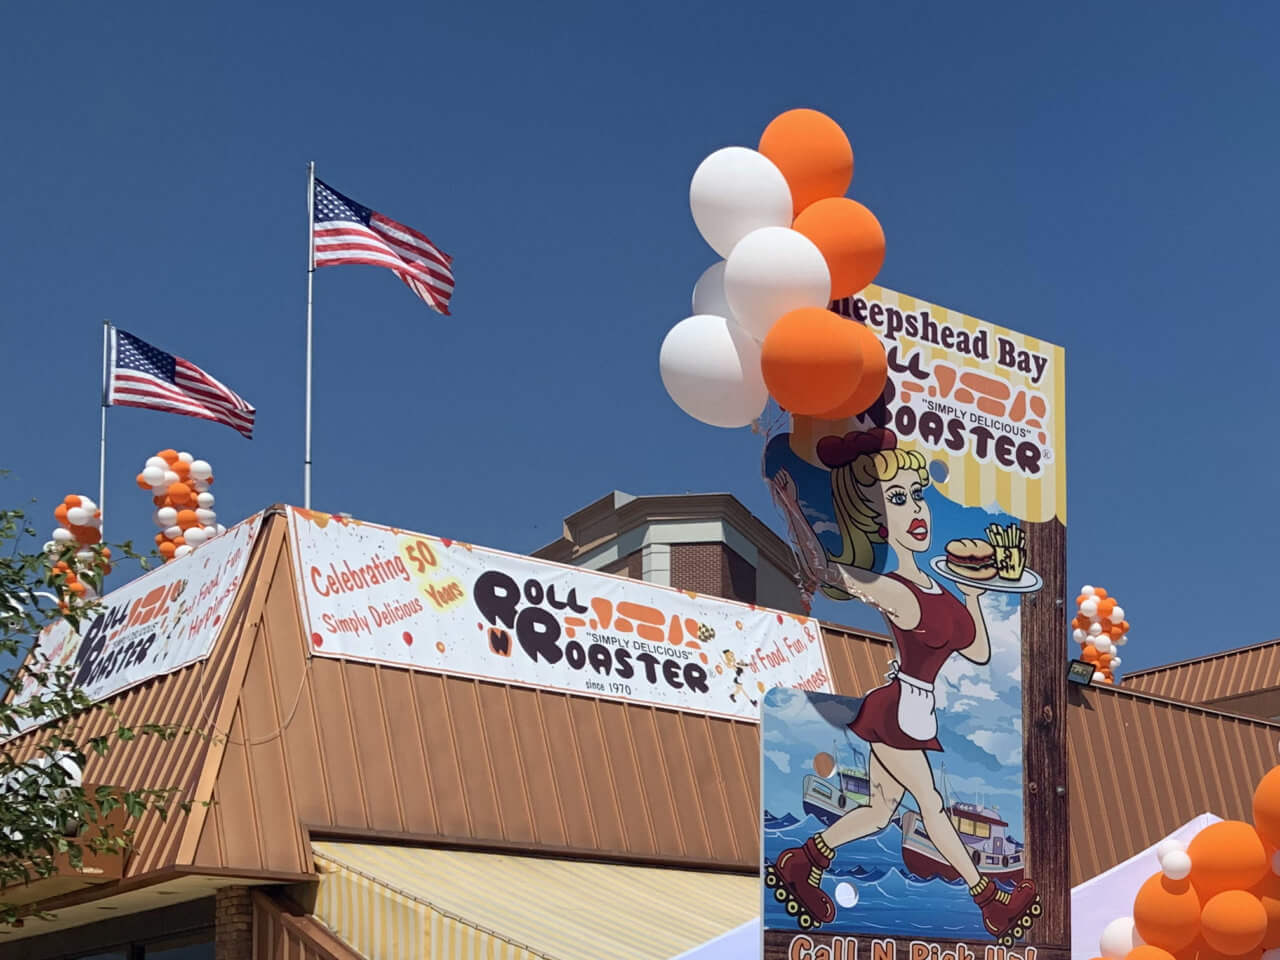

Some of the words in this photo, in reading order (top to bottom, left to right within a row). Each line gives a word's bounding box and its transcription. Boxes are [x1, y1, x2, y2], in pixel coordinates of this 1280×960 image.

[829, 296, 989, 361] eepshead
[998, 338, 1048, 384] Bay
[311, 554, 410, 597] Celebrating
[405, 541, 437, 573] 50
[322, 611, 370, 638] Simply
[368, 598, 423, 628] Delicious
[424, 581, 464, 608] Years
[473, 570, 588, 629] ROLL
[72, 633, 156, 690] ROASTER
[488, 627, 512, 657] N
[516, 607, 709, 694] ROASTER
[755, 639, 790, 670] Food,
[783, 637, 808, 657] Fun,
[804, 626, 816, 644] &
[585, 679, 605, 692] since
[608, 682, 632, 696] 1970
